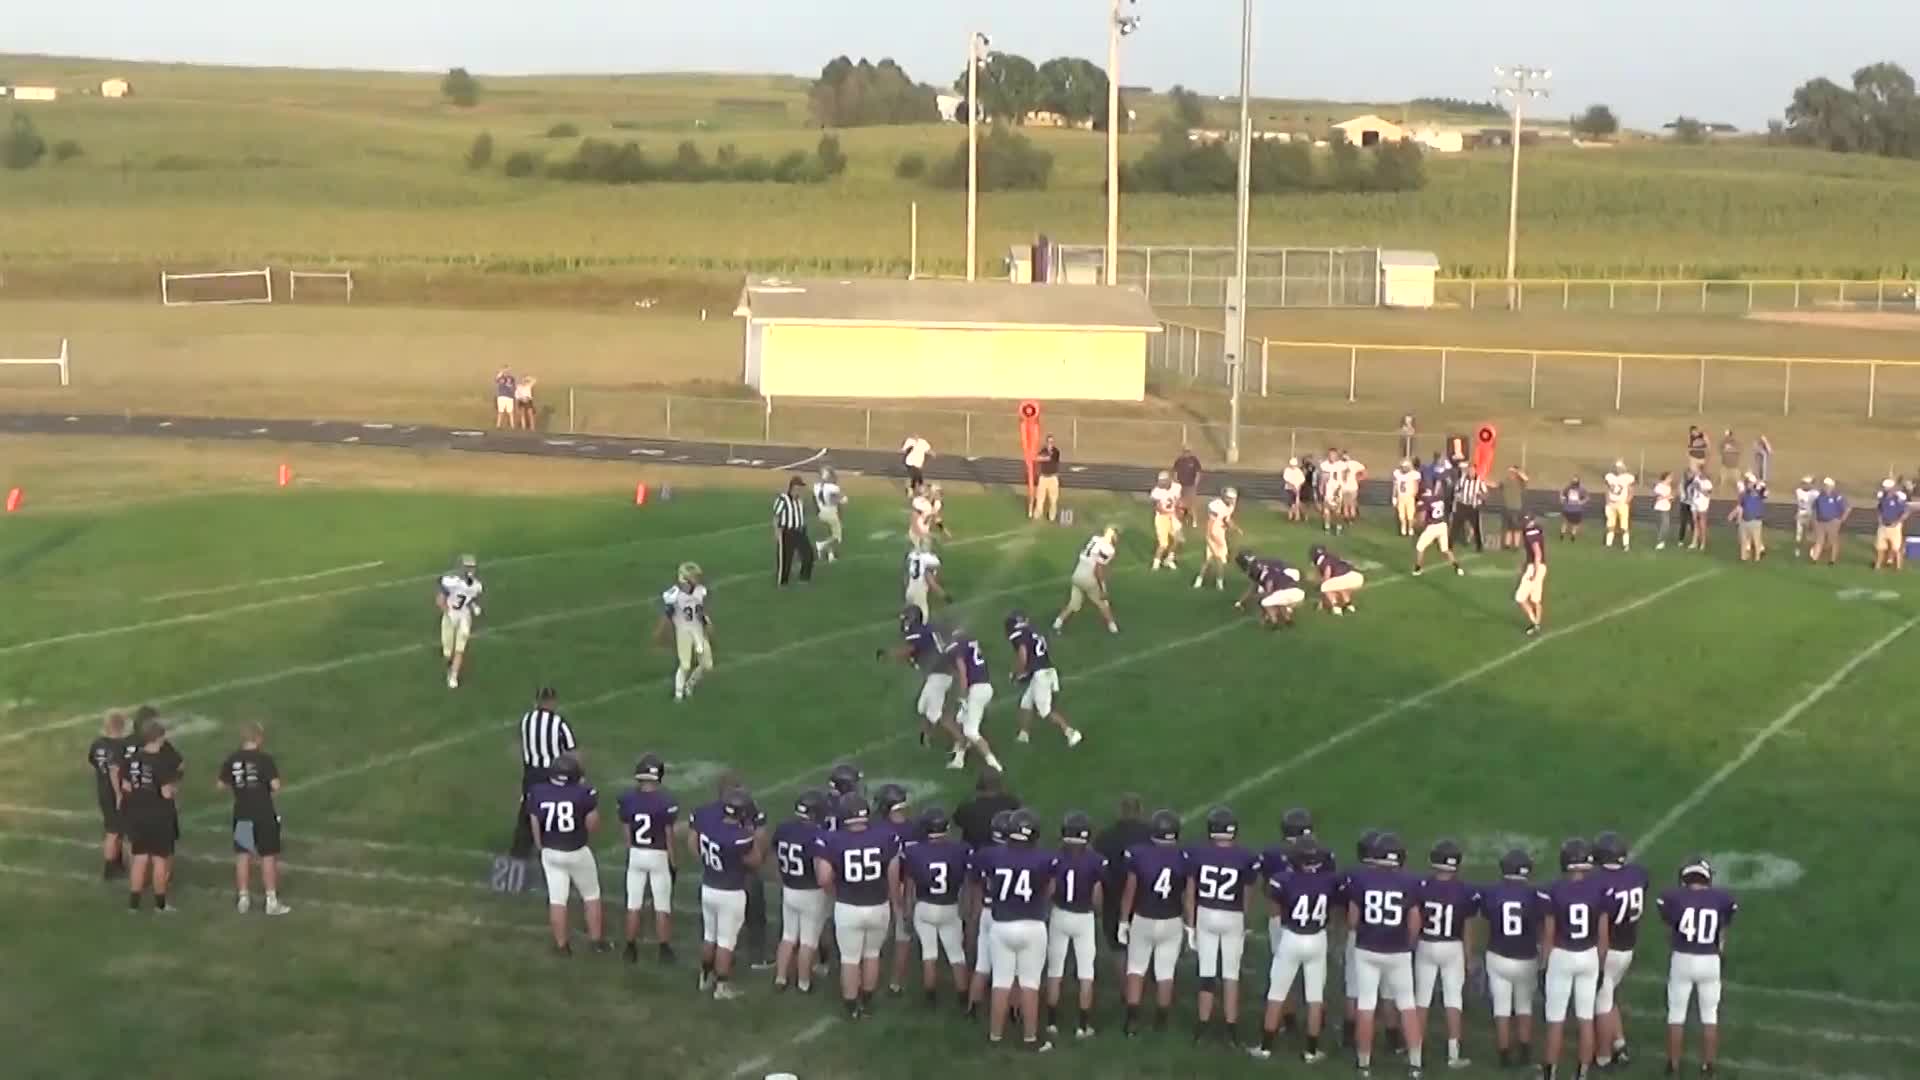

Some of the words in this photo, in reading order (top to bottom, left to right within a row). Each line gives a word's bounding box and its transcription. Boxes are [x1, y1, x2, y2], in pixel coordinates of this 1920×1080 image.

[539, 800, 575, 833] 78
[634, 813, 652, 845] 2
[491, 857, 525, 893] 20
[777, 841, 804, 876] 55
[844, 846, 882, 882] 65
[928, 861, 948, 894] 3
[995, 868, 1033, 902] 74
[1066, 869, 1075, 903] 1
[1153, 867, 1172, 899] 4
[1198, 864, 1239, 901] 52
[1291, 893, 1328, 927] 44
[1364, 890, 1403, 926] 85
[1423, 901, 1454, 937] 31
[1502, 900, 1523, 936] 6
[1569, 902, 1589, 939] 9
[1614, 886, 1644, 925] 79
[1678, 906, 1719, 944] 40
